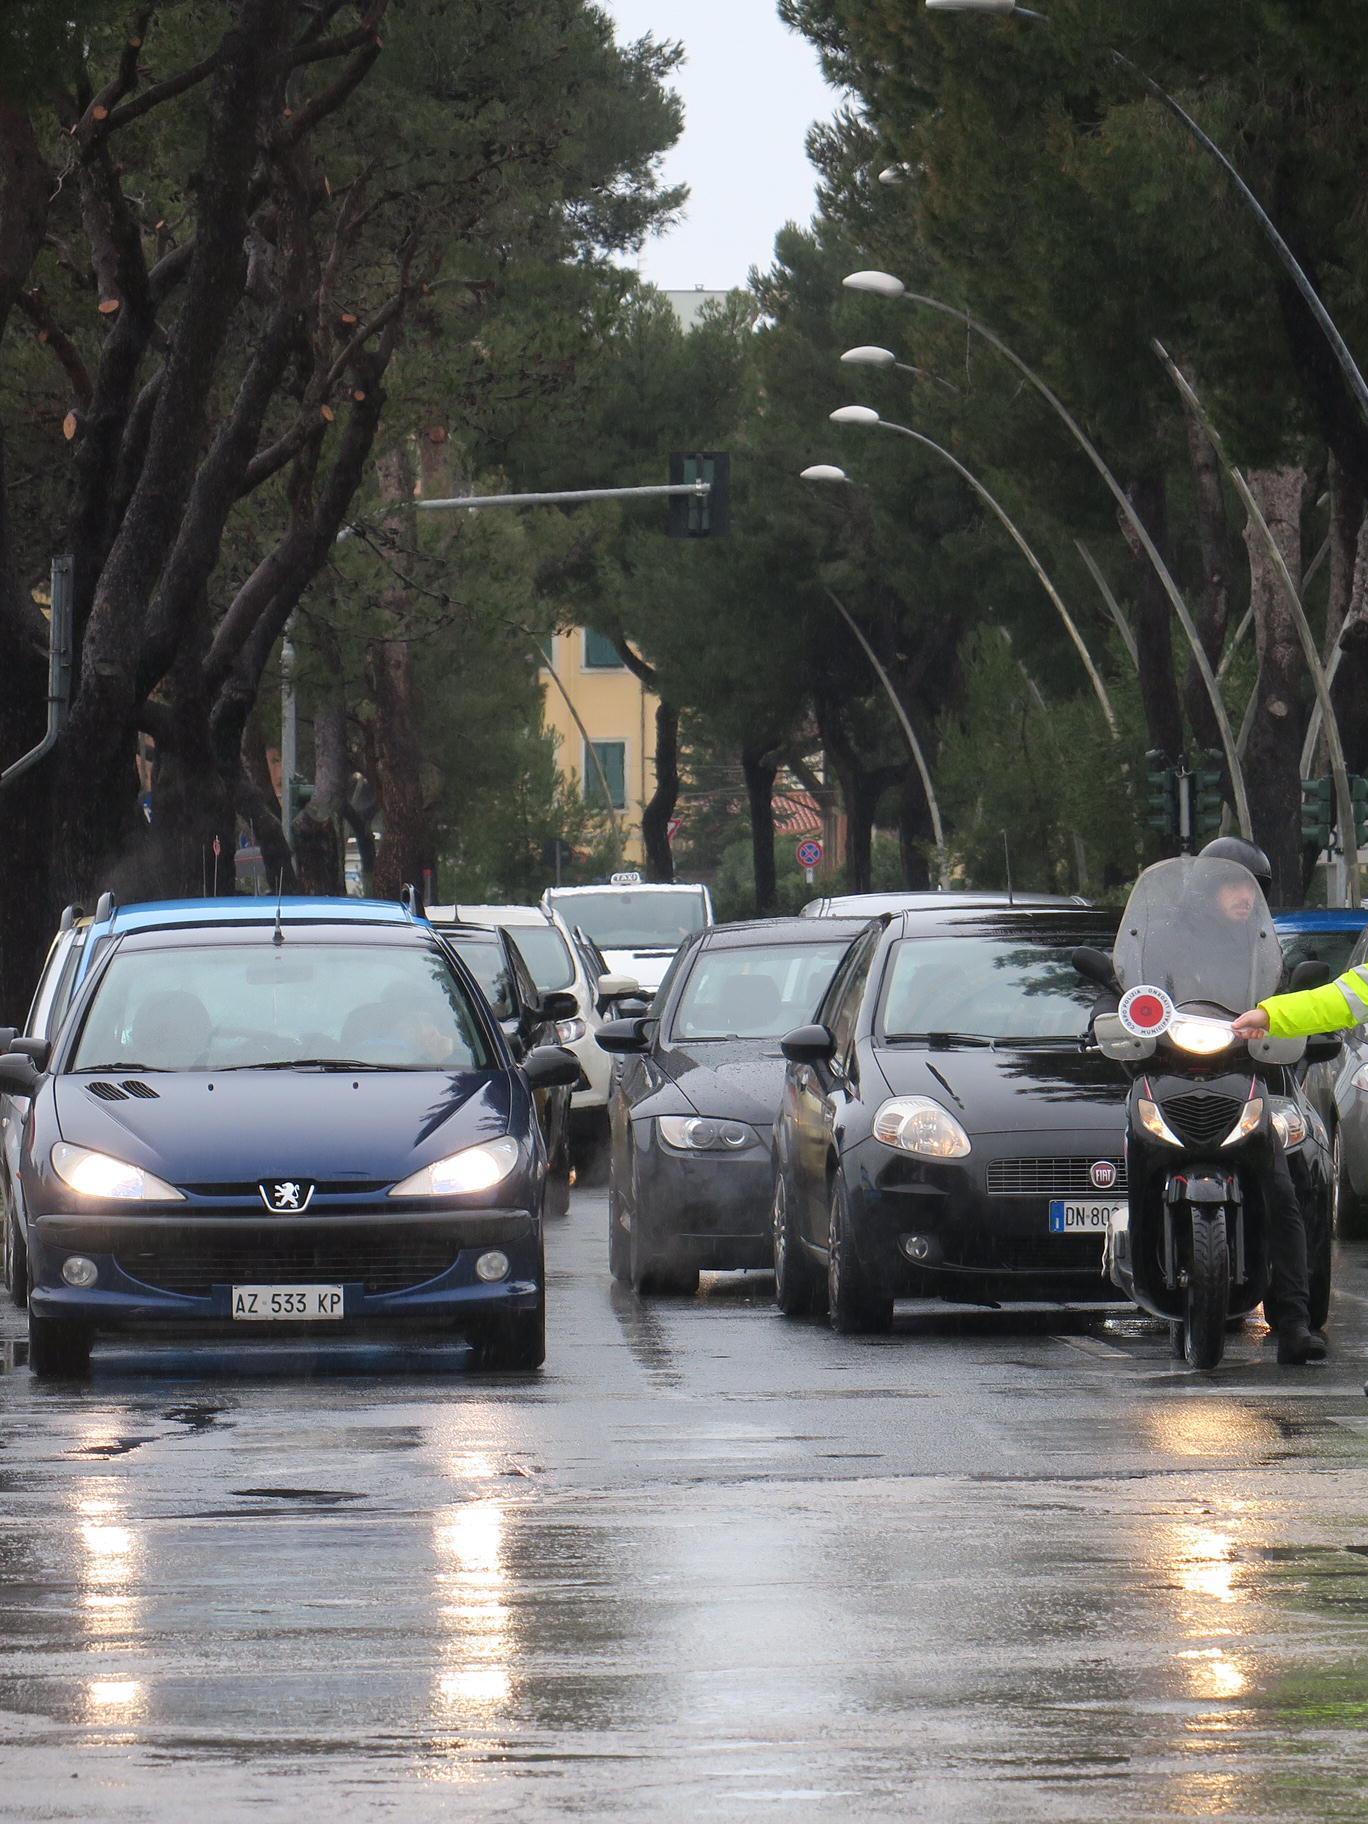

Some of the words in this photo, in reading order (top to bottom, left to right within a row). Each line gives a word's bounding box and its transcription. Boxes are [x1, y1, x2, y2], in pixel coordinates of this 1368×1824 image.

[612, 874, 638, 882] TAXI
[1123, 990, 1141, 1008] POLIZIA
[1141, 1011, 1171, 1035] MUNICIPALE
[1095, 1169, 1112, 1182] FIAT
[1066, 1207, 1085, 1226] DN
[1090, 1207, 1120, 1226] 80
[235, 1293, 258, 1313] AZ
[271, 1293, 306, 1313] 533
[318, 1293, 341, 1313] KP
